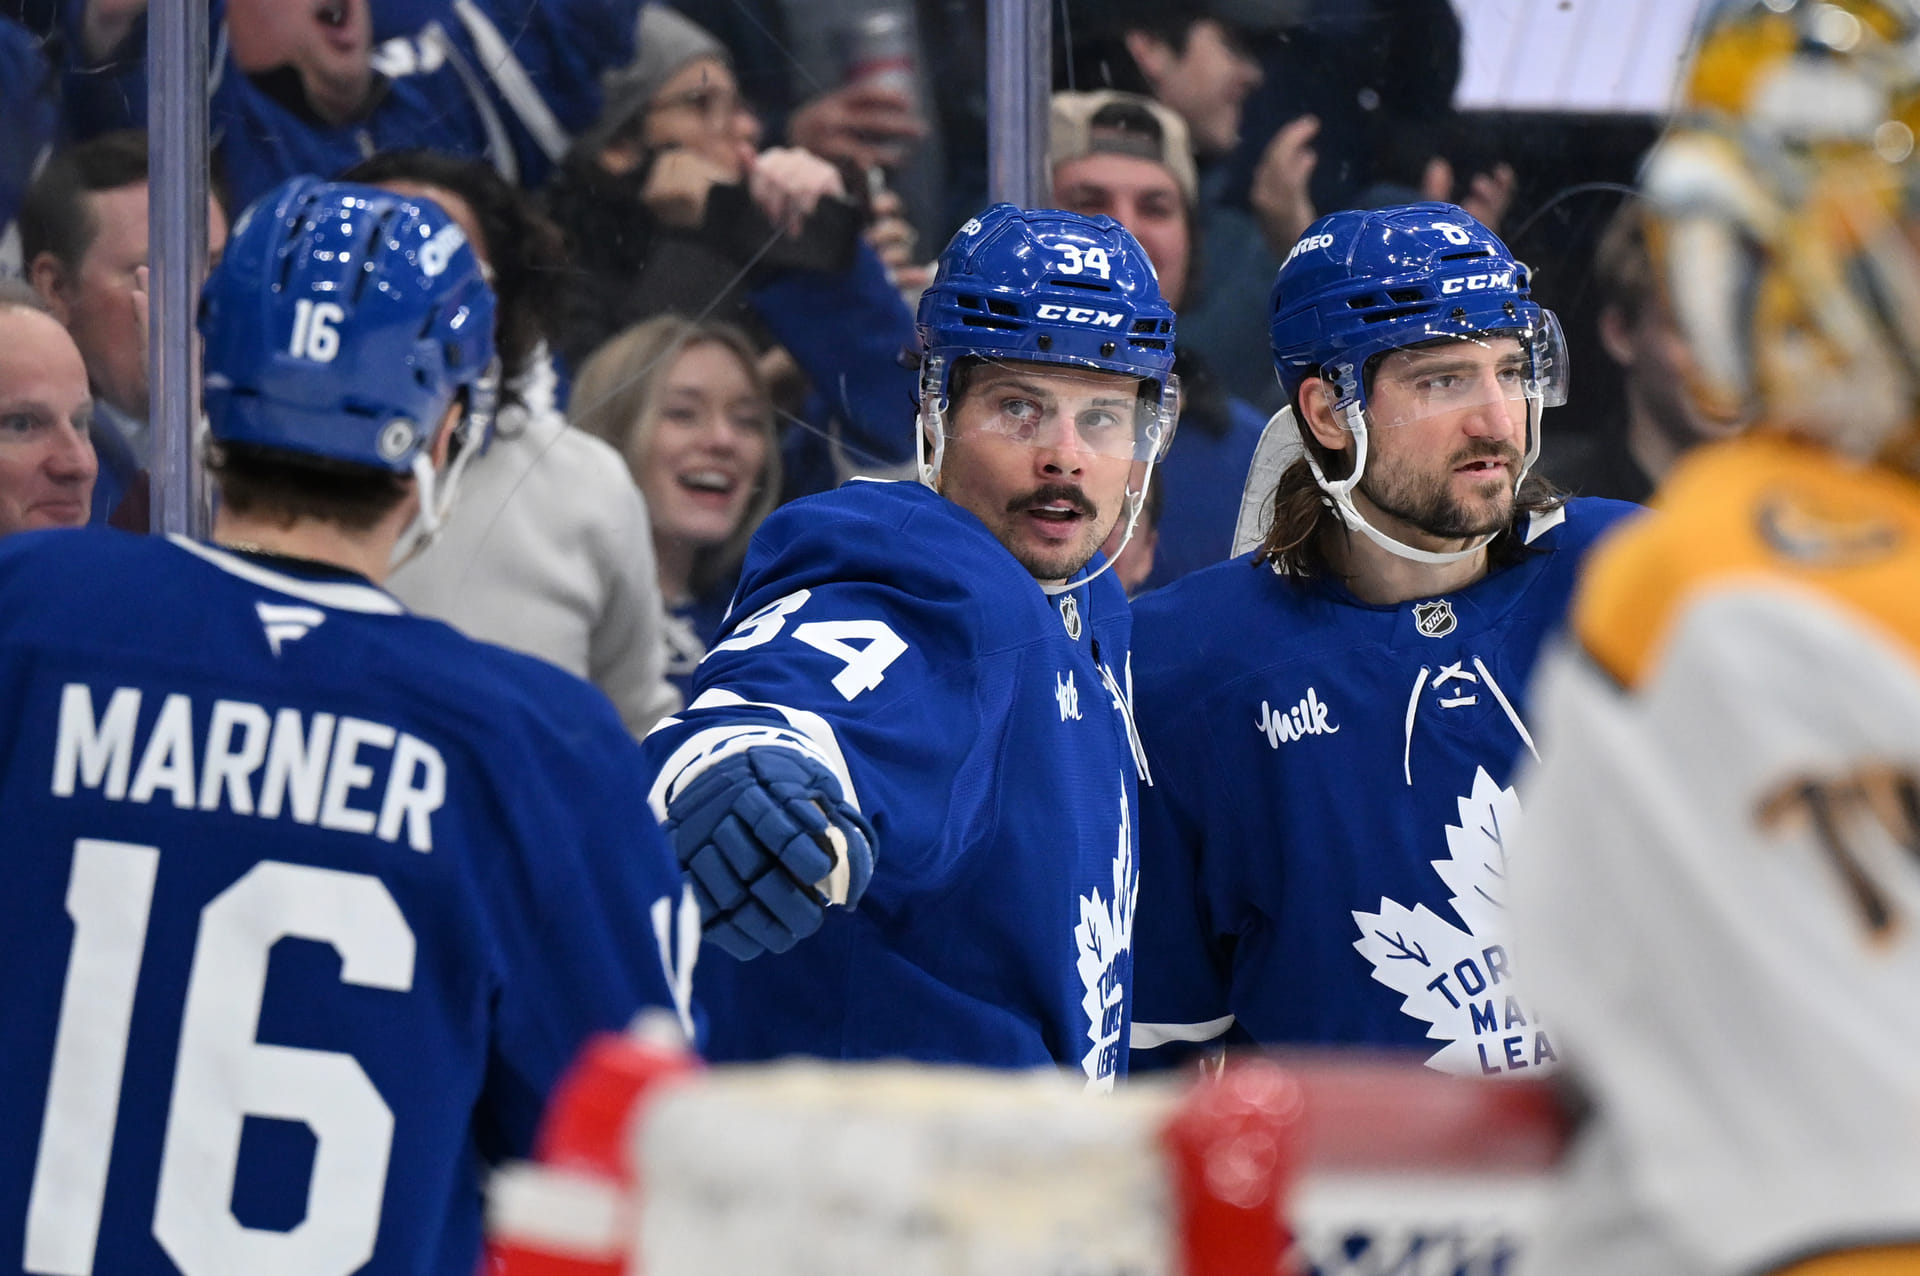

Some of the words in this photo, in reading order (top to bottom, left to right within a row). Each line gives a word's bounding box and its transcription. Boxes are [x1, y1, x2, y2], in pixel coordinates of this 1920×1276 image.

[1431, 222, 1471, 246] 8
[1054, 243, 1111, 280] 34
[1441, 273, 1510, 294] CCM
[289, 299, 345, 363] 16
[1036, 303, 1124, 328] CCM
[1424, 605, 1446, 632] NHL
[1255, 687, 1340, 749] Milk
[51, 683, 446, 854] MARNER
[1426, 944, 1513, 1010] TOR
[1469, 994, 1532, 1036] MA
[23, 837, 416, 1276] 16
[1477, 1030, 1558, 1076] LEA
